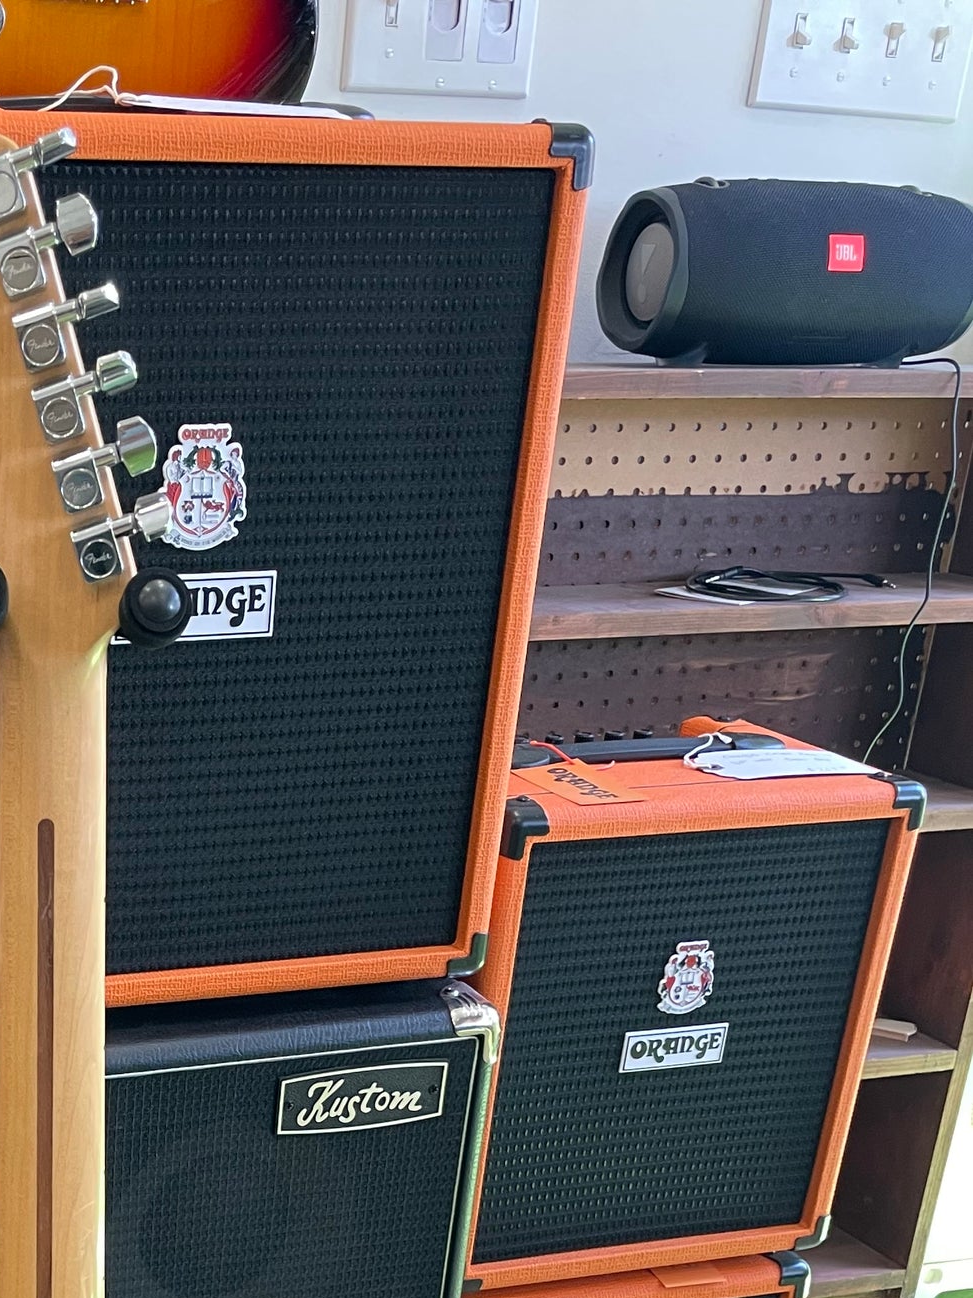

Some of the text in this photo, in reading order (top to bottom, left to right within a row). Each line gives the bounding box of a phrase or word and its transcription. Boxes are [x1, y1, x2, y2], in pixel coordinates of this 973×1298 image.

[835, 244, 857, 261] JBL
[26, 338, 56, 354] Fender
[45, 410, 74, 426] Fender
[181, 427, 230, 444] ORANGE
[83, 552, 113, 568] Fender
[547, 767, 619, 799] ORANGE
[630, 1032, 722, 1063] ORANGE
[296, 1078, 422, 1127] Kustom
